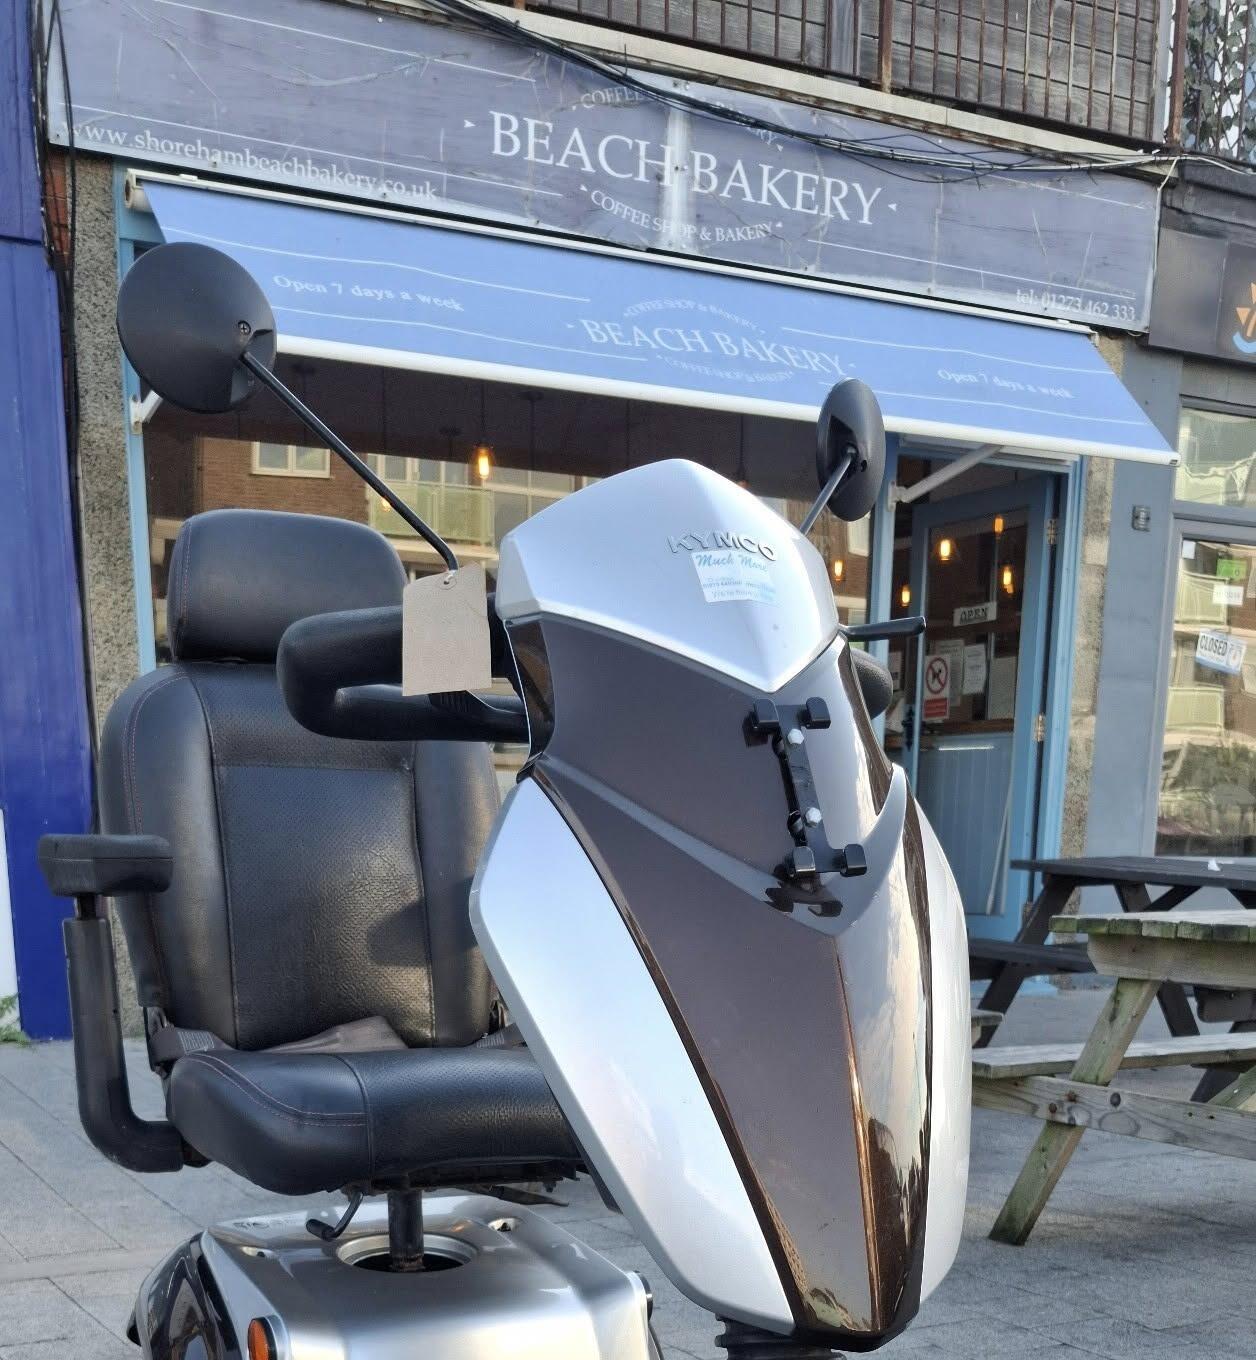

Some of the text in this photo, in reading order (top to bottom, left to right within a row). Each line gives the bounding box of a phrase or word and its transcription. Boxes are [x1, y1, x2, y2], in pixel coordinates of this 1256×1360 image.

[489, 110, 674, 187] BEACH
[690, 150, 884, 225] BAKERY
[591, 189, 652, 229] COFFEE
[699, 226, 712, 241] &
[716, 222, 773, 242] BAKERY
[272, 274, 465, 312] Open 7 days a week
[1112, 304, 1136, 322] 333
[579, 318, 848, 377] BEACH BAKERY
[665, 530, 777, 562] KYMCO
[695, 552, 735, 569] Much
[1200, 634, 1228, 657] CLOSED
